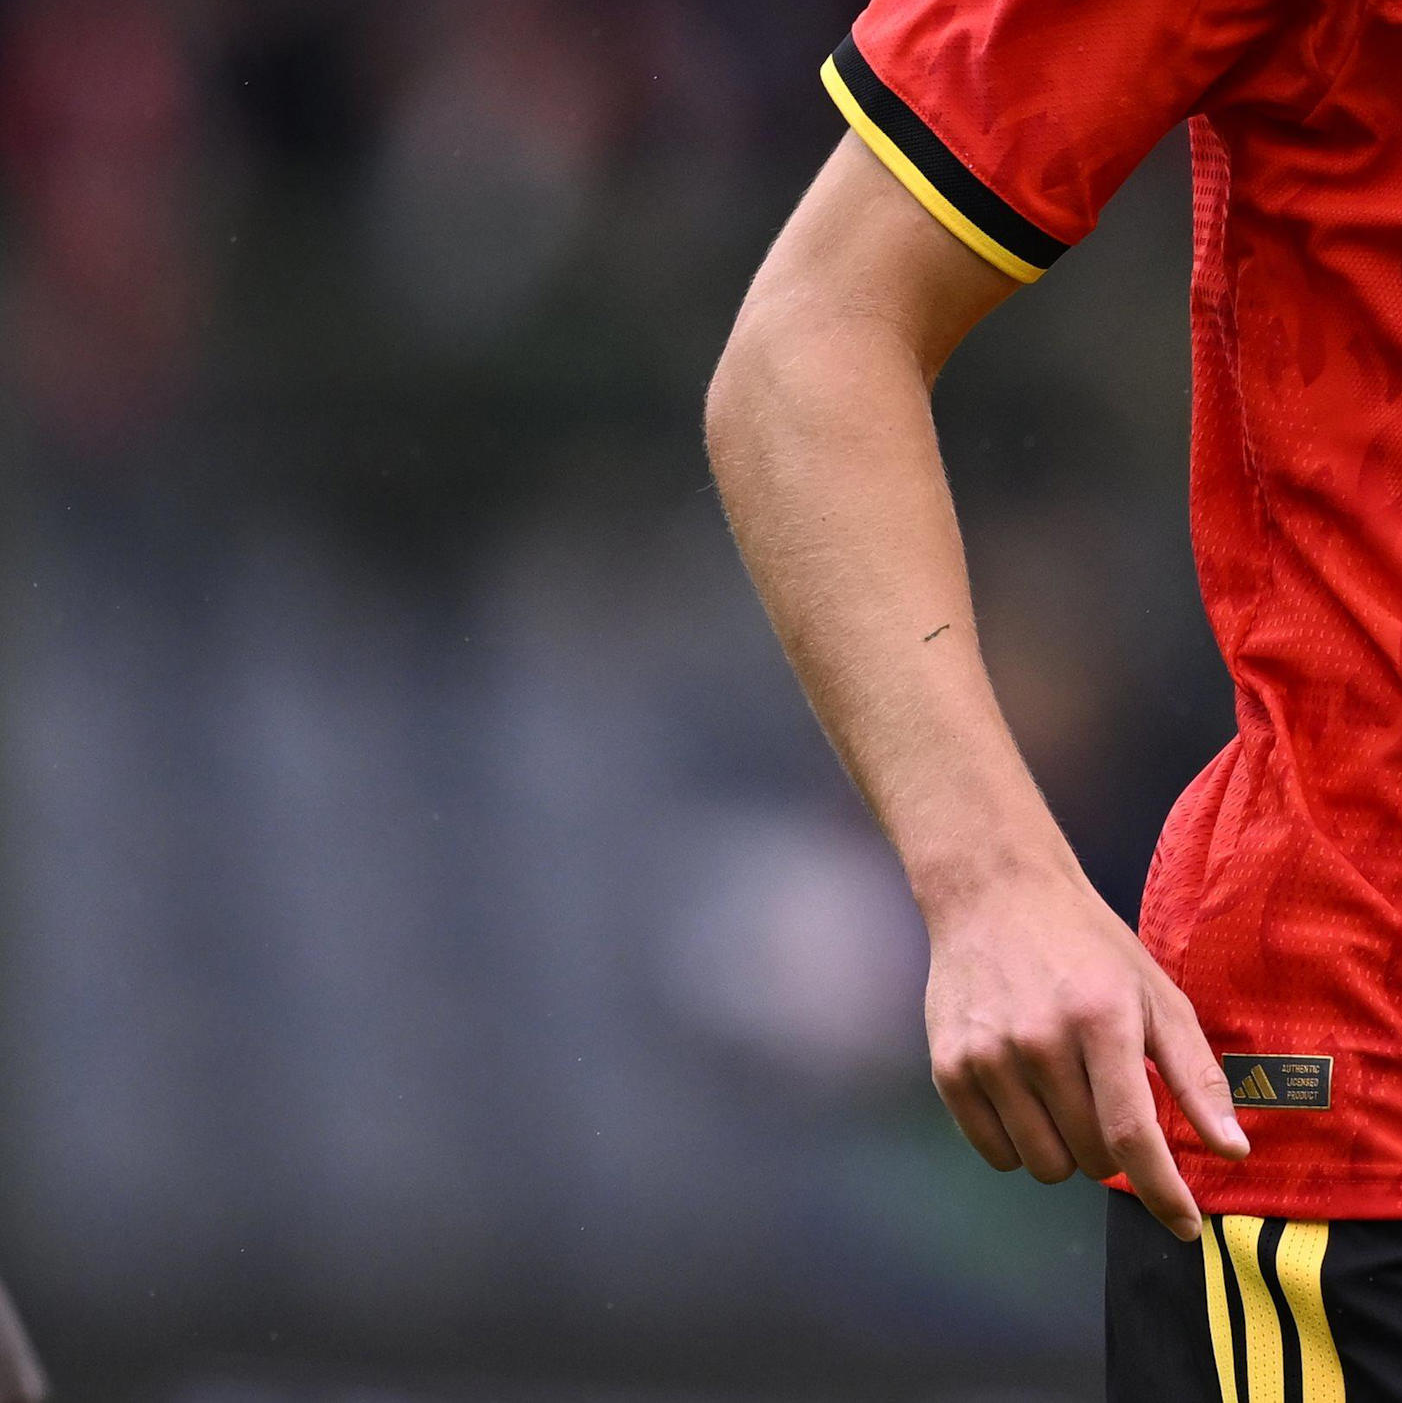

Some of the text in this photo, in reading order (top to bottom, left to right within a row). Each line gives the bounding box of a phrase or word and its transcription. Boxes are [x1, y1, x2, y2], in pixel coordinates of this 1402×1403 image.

[1281, 1064, 1320, 1074] AUTHENTIC
[1286, 1077, 1319, 1087] LICENSED
[1286, 1090, 1319, 1101] PRODUCT
